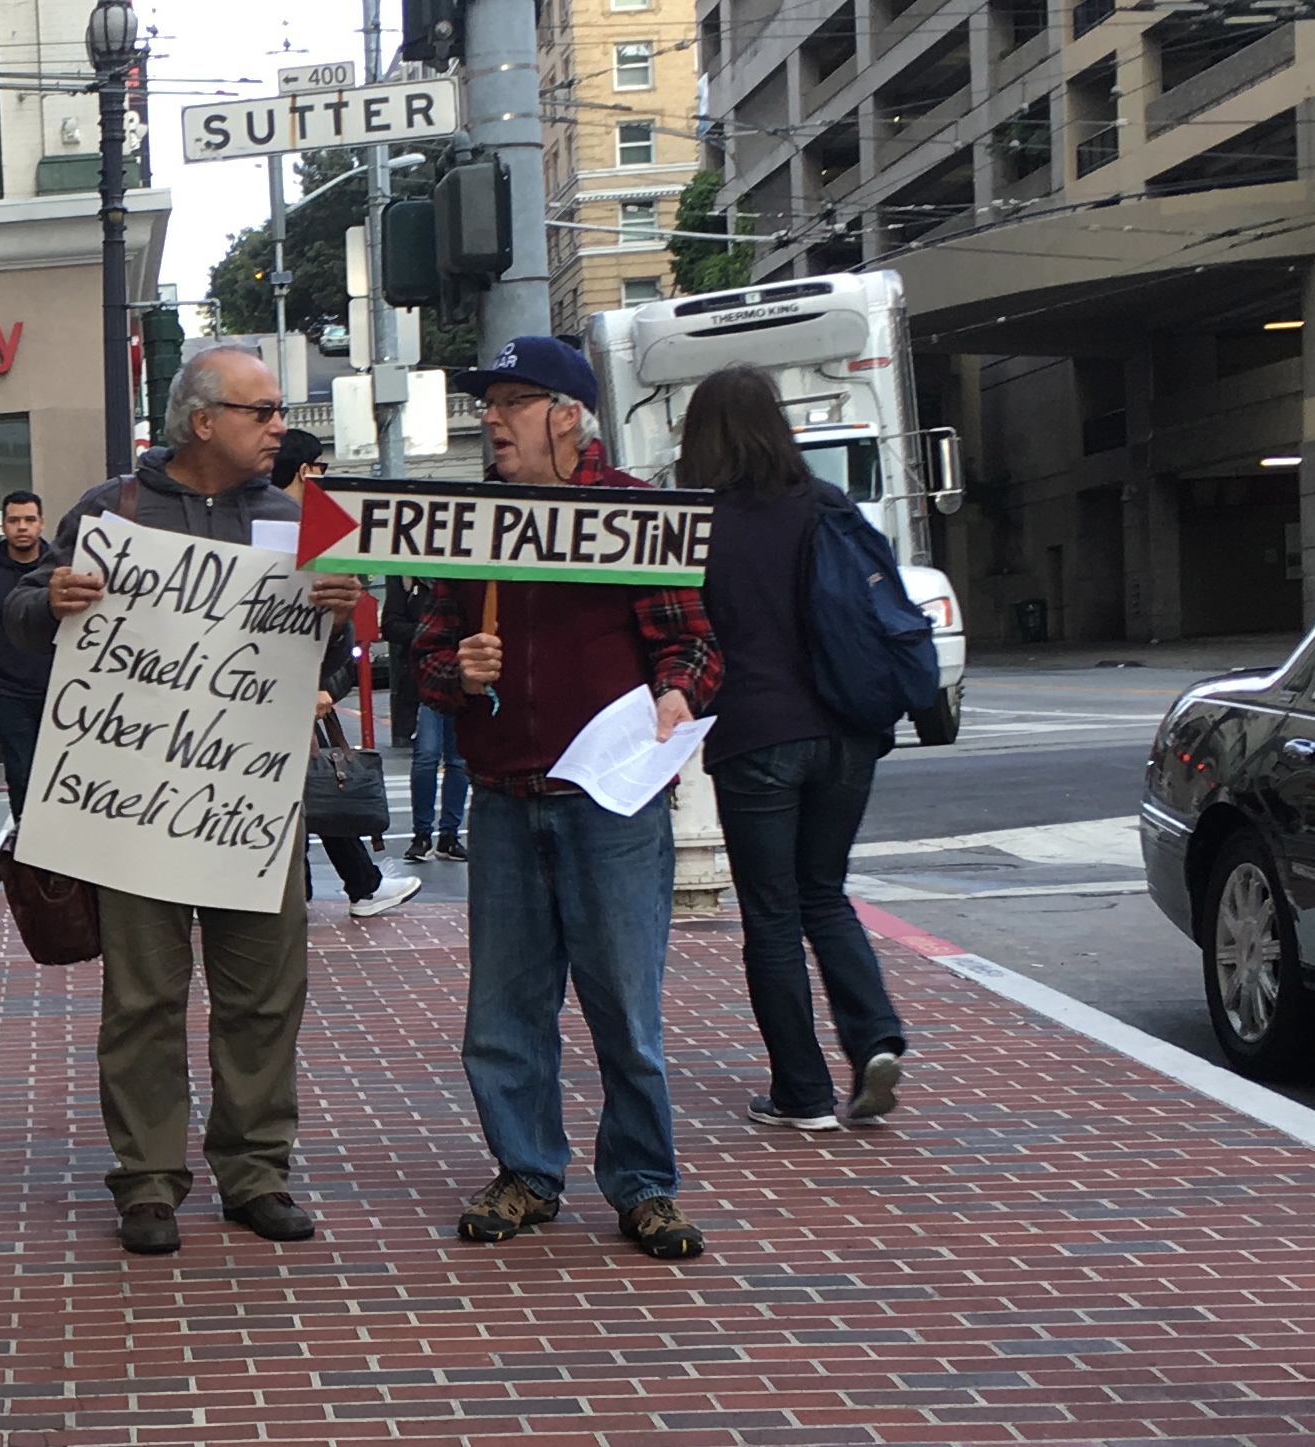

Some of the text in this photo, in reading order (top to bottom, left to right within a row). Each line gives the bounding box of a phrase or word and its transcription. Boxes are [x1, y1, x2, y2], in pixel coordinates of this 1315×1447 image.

[307, 65, 347, 86] 400
[203, 92, 435, 150] SUTTER
[710, 303, 800, 325] THERMO KING
[357, 499, 477, 558] FREE
[82, 527, 160, 612] Stop
[210, 642, 278, 705] Gov.
[51, 678, 291, 782] Cyber War on
[42, 751, 299, 878] Israeli Critics!
